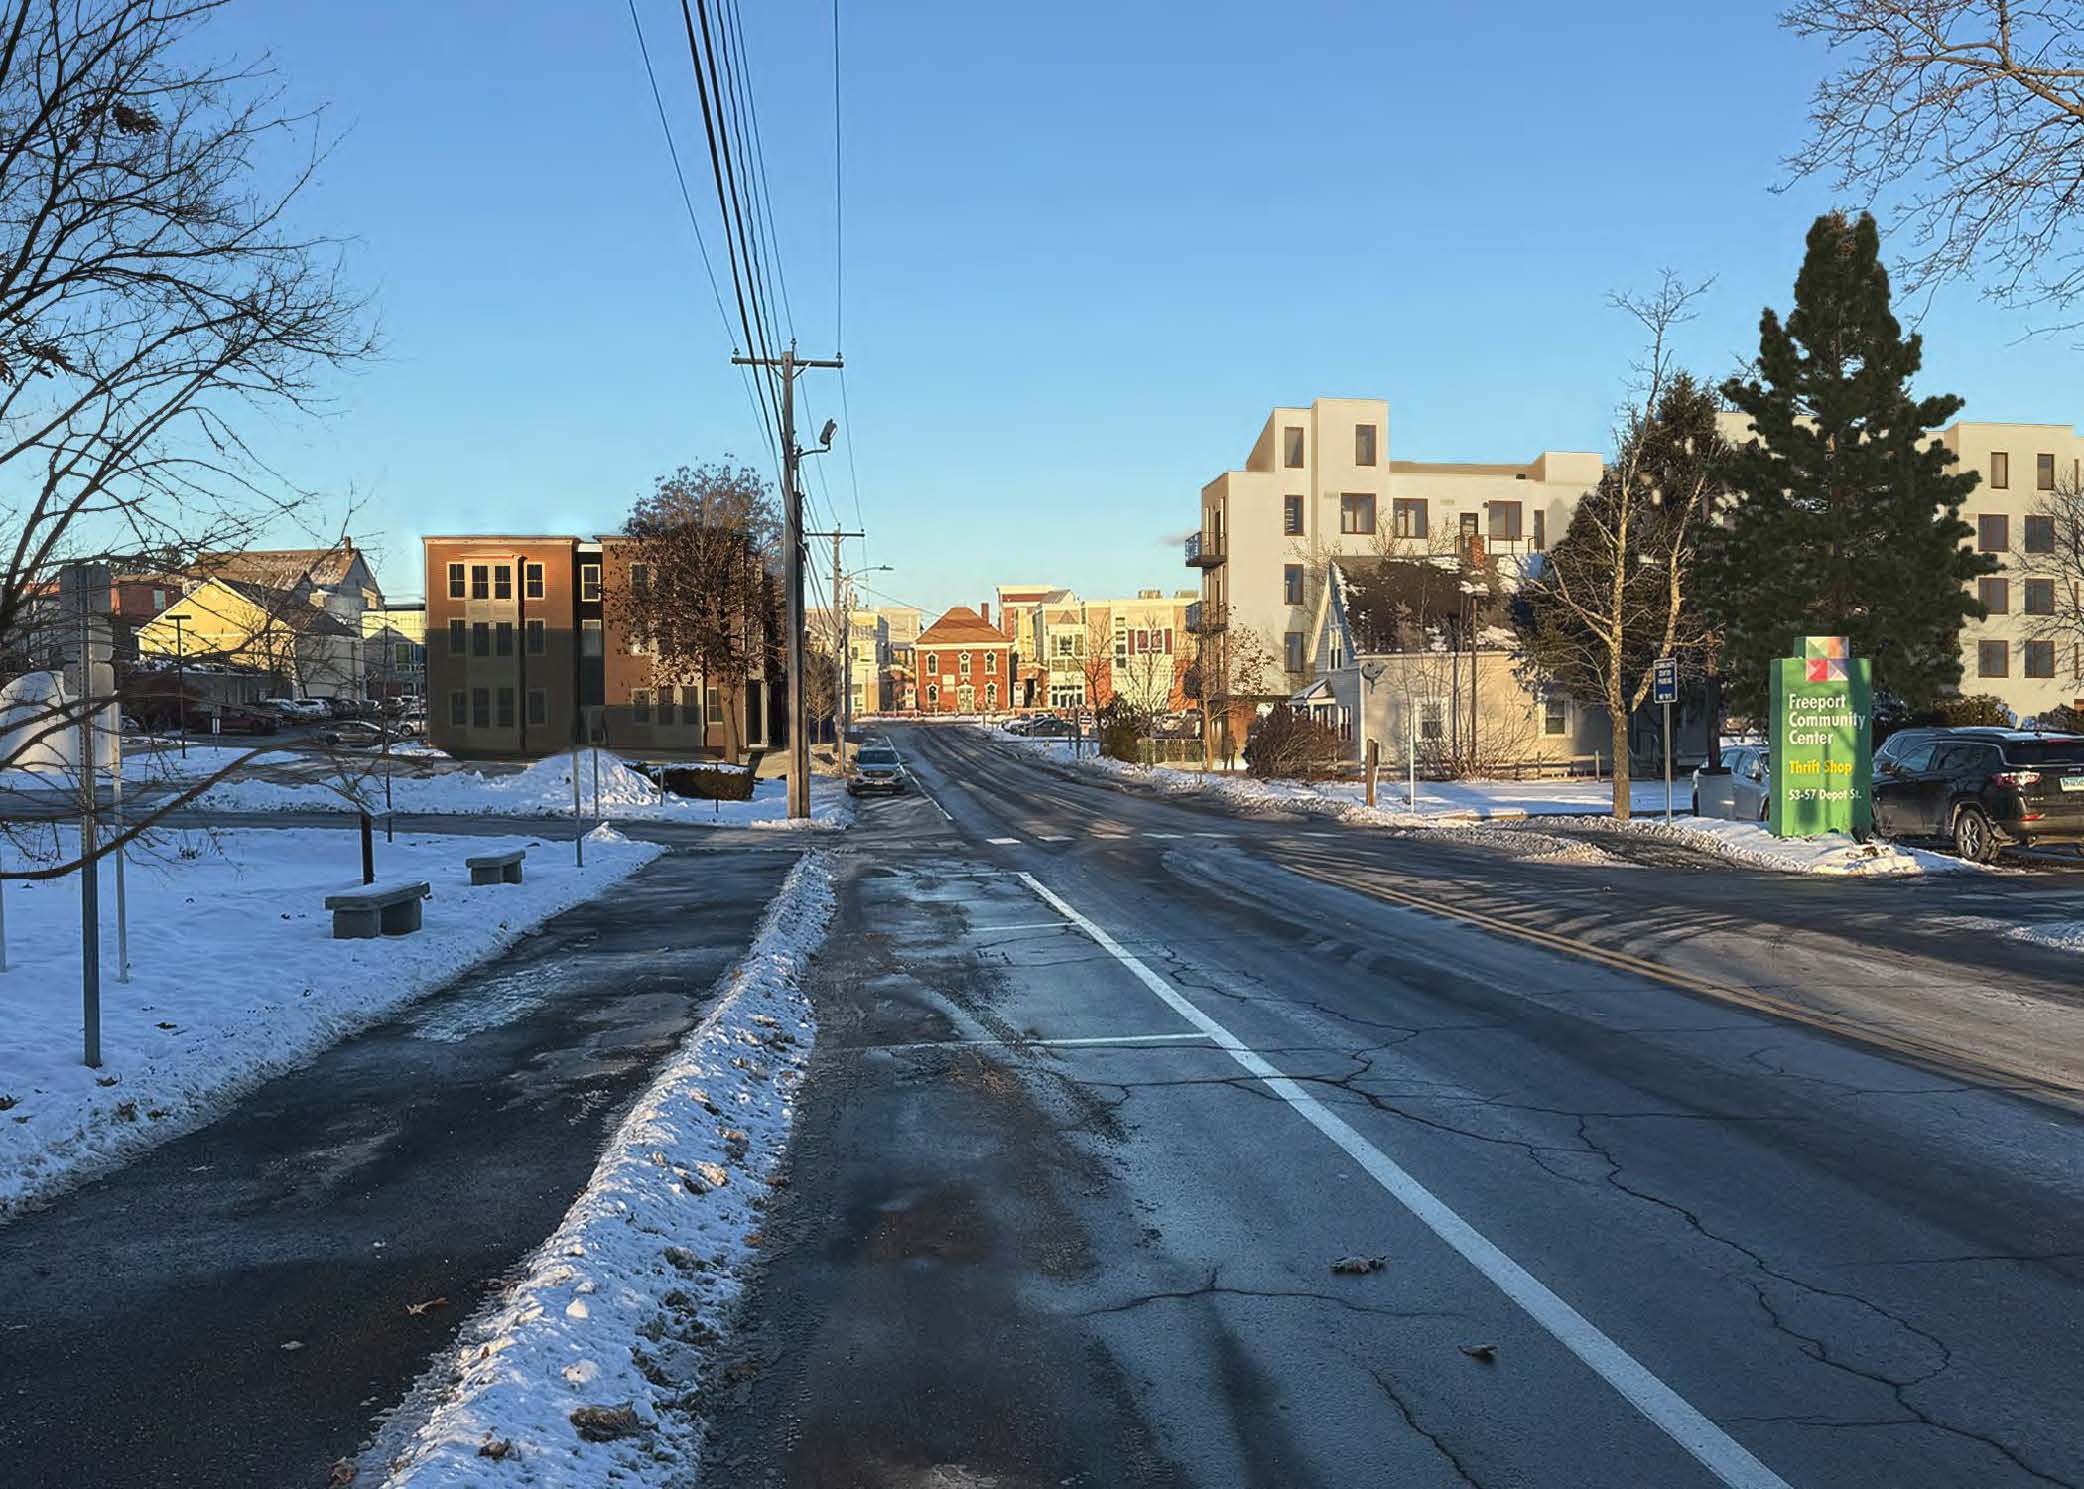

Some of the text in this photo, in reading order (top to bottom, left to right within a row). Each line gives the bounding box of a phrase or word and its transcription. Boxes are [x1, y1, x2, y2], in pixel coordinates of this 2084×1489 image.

[1789, 693, 1846, 712] Freeport
[1789, 712, 1865, 730] Community
[1789, 730, 1834, 745] Center
[1789, 760, 1853, 775] Thrift Shop
[1789, 789, 1816, 801] 53-57
[1819, 789, 1848, 801] Depot
